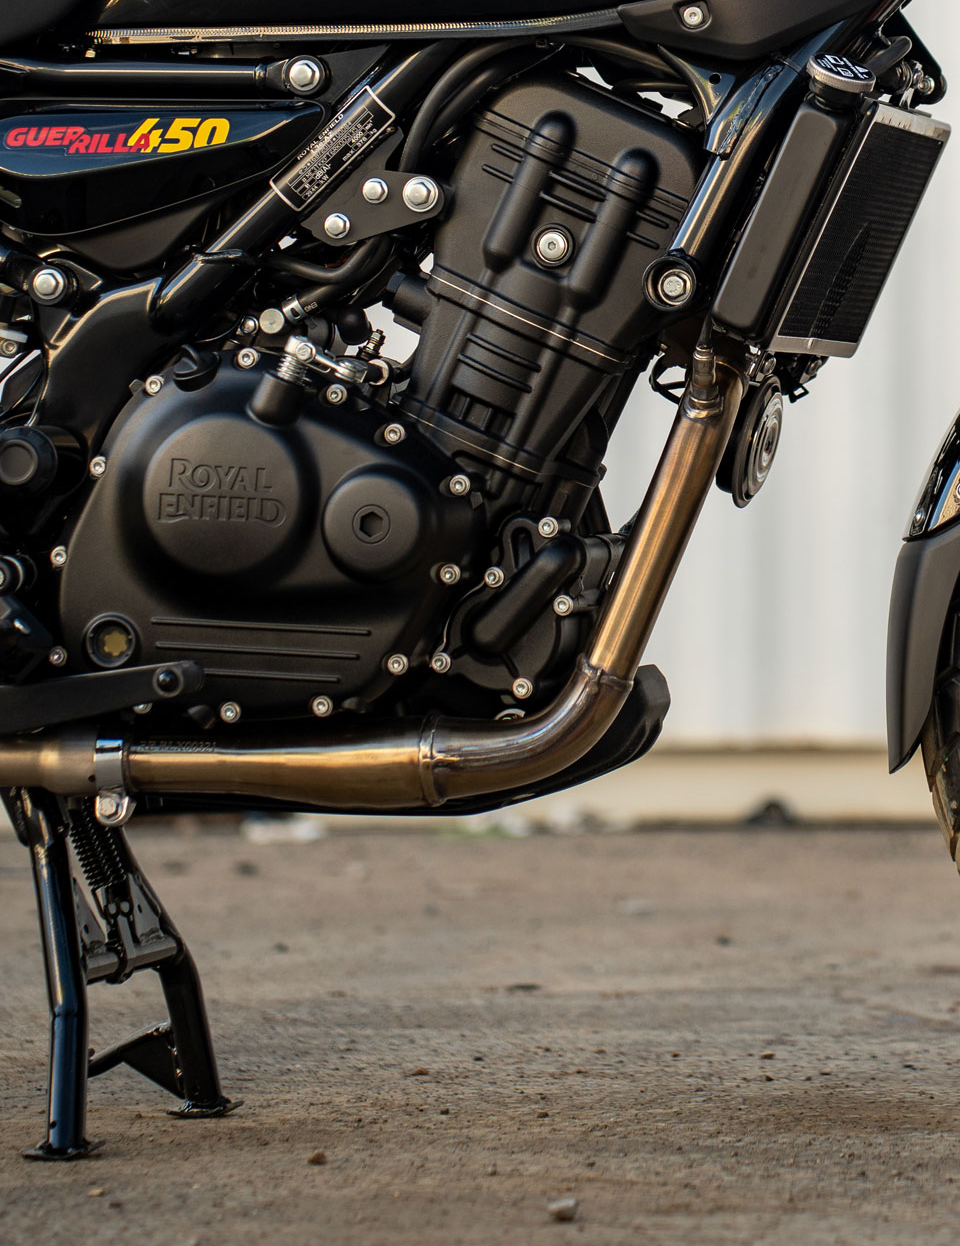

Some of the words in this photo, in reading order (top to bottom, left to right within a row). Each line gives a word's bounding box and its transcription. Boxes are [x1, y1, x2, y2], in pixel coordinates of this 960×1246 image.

[6, 126, 150, 154] GUERRILLA
[127, 117, 230, 153] 450
[167, 457, 273, 492] ROYAL
[156, 492, 287, 528] ENFIELD
